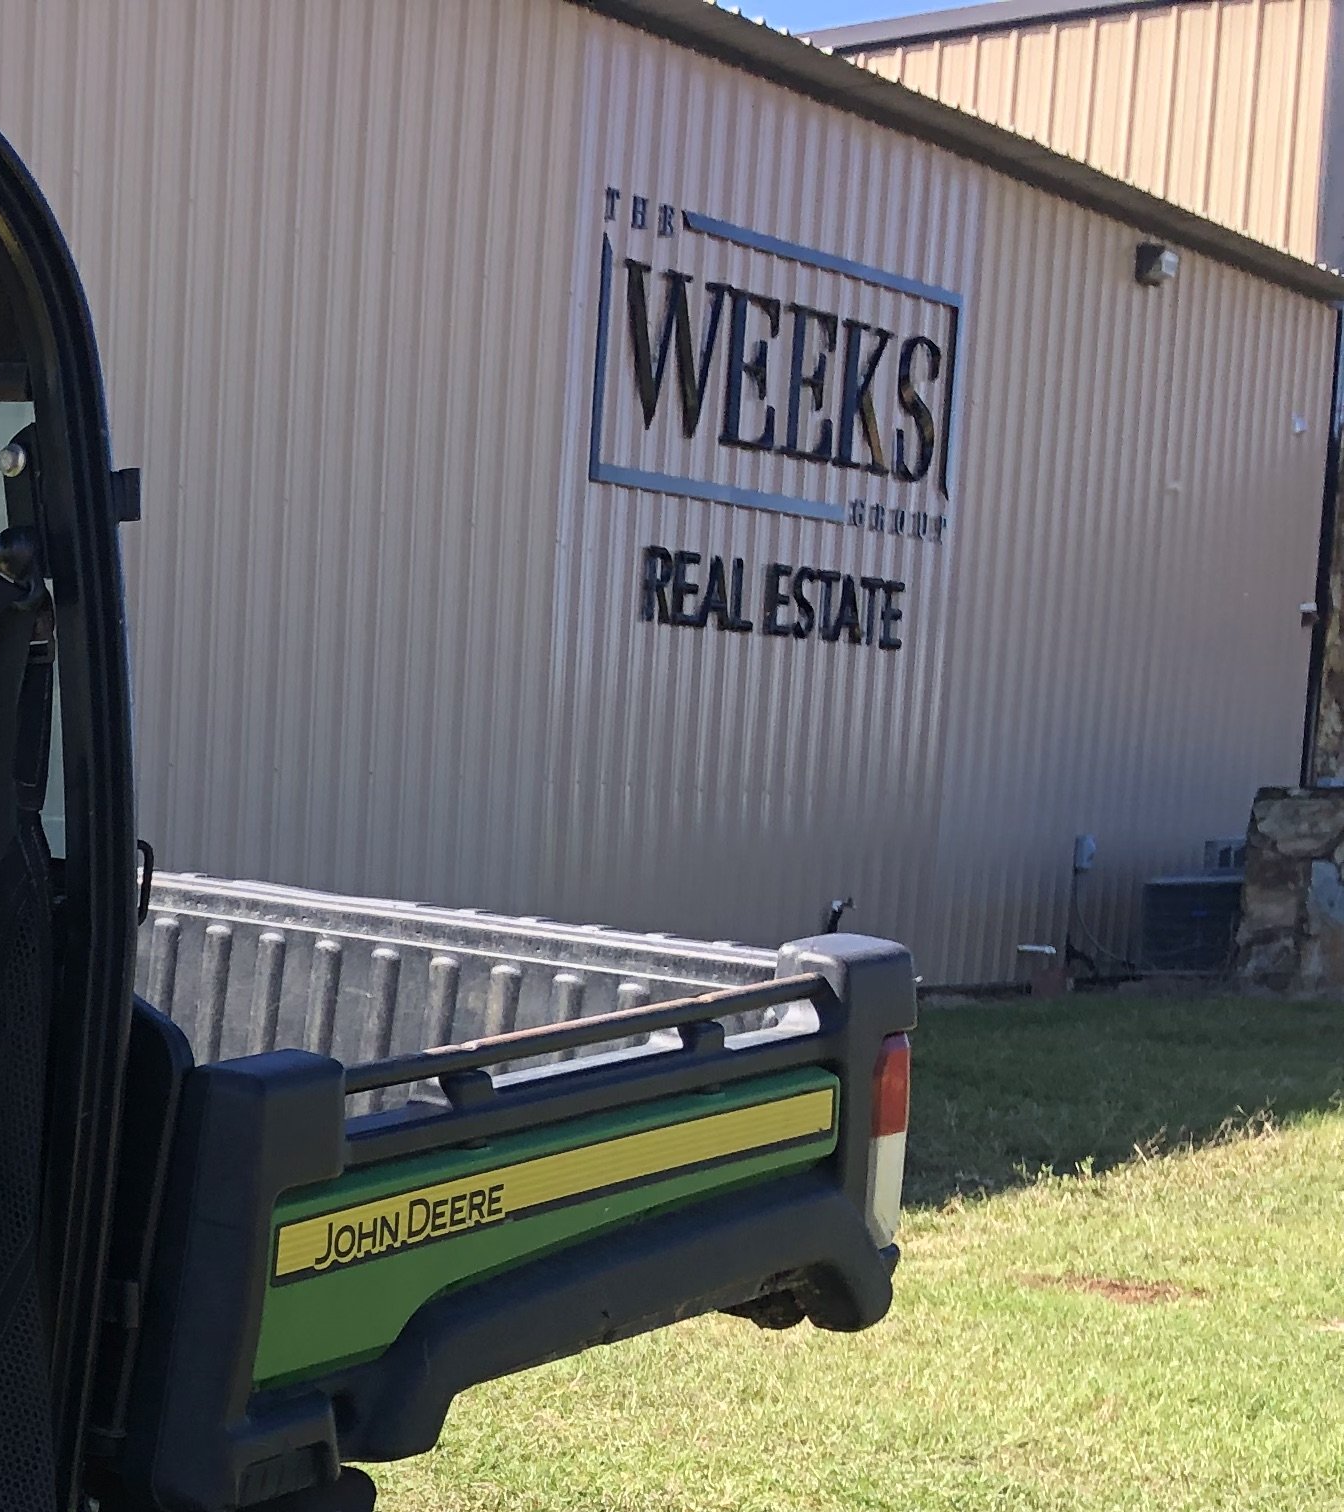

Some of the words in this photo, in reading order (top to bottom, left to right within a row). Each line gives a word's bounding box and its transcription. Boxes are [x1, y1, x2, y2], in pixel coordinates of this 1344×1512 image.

[603, 187, 676, 238] THE
[624, 258, 942, 484] WEEKS
[848, 498, 948, 545] GROUP
[641, 545, 754, 633] REAL
[762, 562, 906, 651] ESTATE
[313, 1211, 401, 1267] JOHN
[407, 1183, 505, 1240] DEERE
